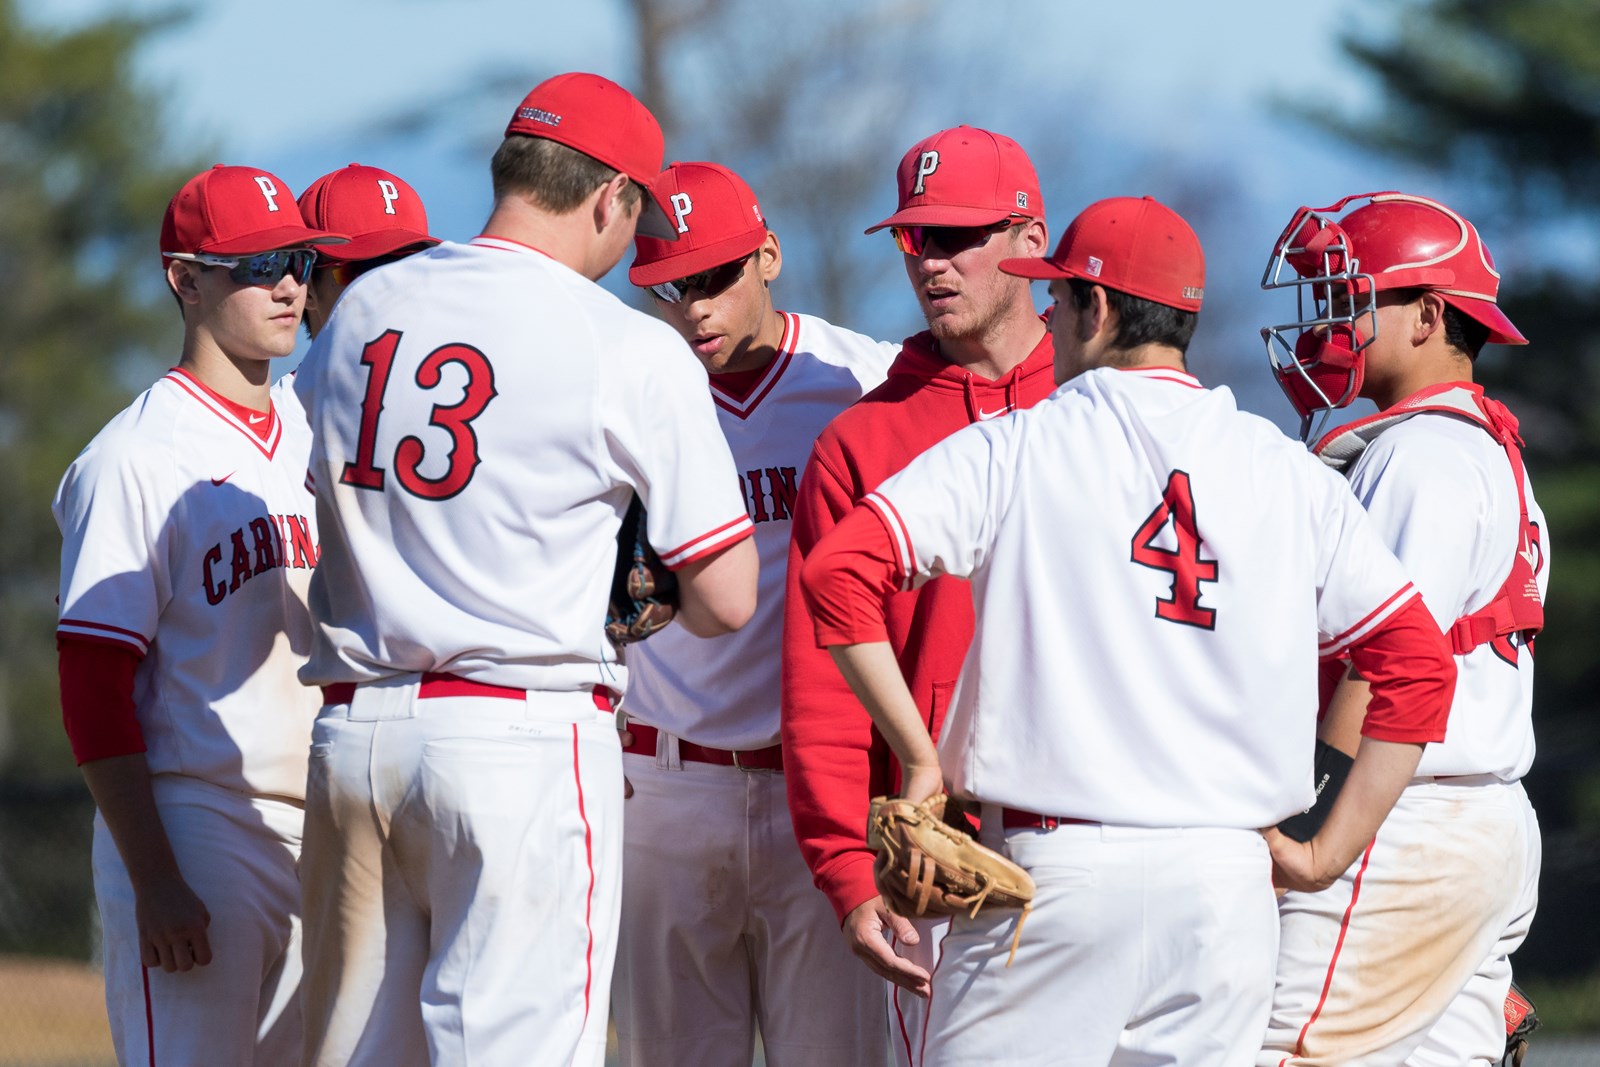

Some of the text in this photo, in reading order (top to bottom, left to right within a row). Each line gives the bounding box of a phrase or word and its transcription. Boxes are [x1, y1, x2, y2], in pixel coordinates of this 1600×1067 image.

[253, 176, 280, 213] P
[912, 150, 941, 196] P
[377, 179, 400, 215] P
[669, 192, 693, 234] P
[339, 328, 499, 502] 13
[202, 513, 322, 606] CARDIN
[1130, 468, 1219, 632] 4
